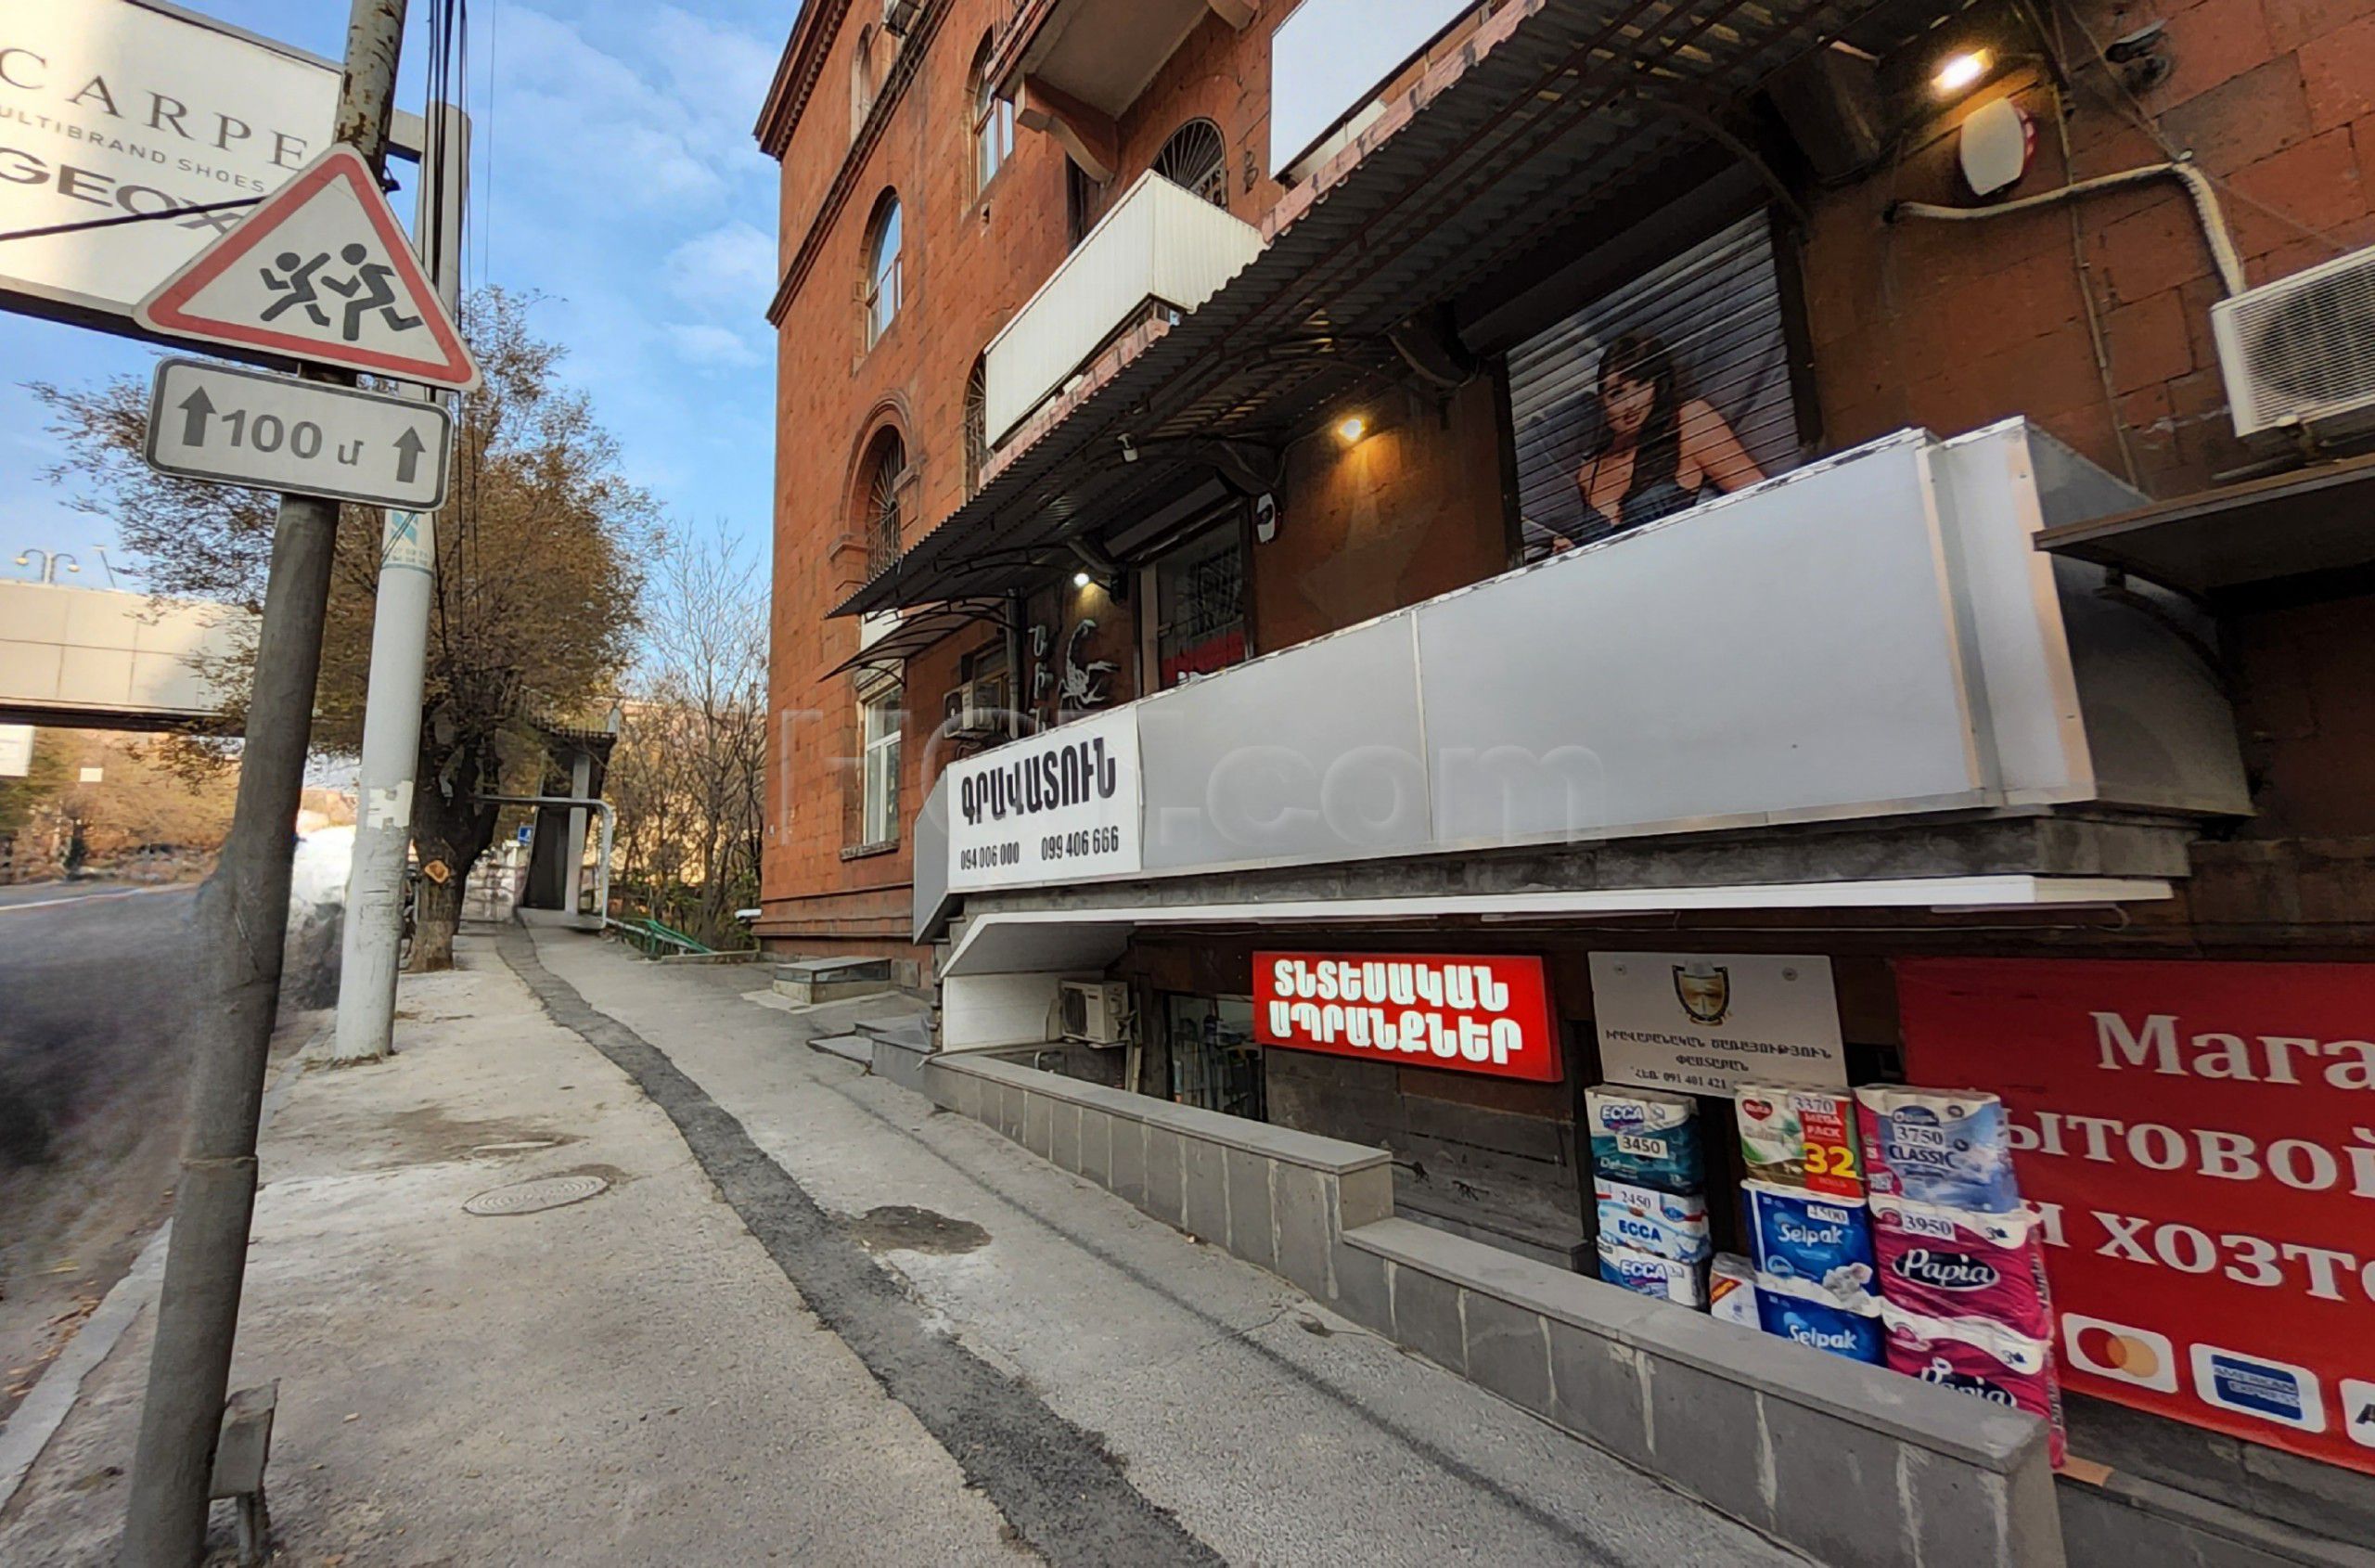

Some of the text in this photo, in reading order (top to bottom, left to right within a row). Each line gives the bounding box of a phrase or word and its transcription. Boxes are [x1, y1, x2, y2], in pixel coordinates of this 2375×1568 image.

[178, 159, 263, 192] SHOES
[0, 147, 245, 234] GEOX
[222, 409, 323, 459] 100
[961, 737, 1116, 825] ԳՐԱՎԱՏՈՒՆ
[960, 826, 1119, 869] 094 006 000 099 406 666
[1274, 959, 1509, 1012] ՏՆՏԵՍԱԿԱՆ
[1269, 1000, 1522, 1064] ԱՊՐԱՆՔՆԵՐ
[2089, 1011, 2375, 1089] Мага
[1600, 1105, 1644, 1120] ECCA
[1795, 1096, 1833, 1113] 3370
[1623, 1137, 1660, 1154] 3450
[1896, 1125, 1944, 1146] 3750
[1803, 1142, 1857, 1178] 32
[1890, 1144, 1960, 1169] CLASSIC
[1621, 1190, 1651, 1209] 2450
[1618, 1219, 1662, 1242] ECCA
[1778, 1224, 1842, 1247] Selpak
[1905, 1215, 1952, 1236] 3950
[1620, 1260, 1667, 1279] ECCA
[1902, 1249, 1991, 1286] Papia
